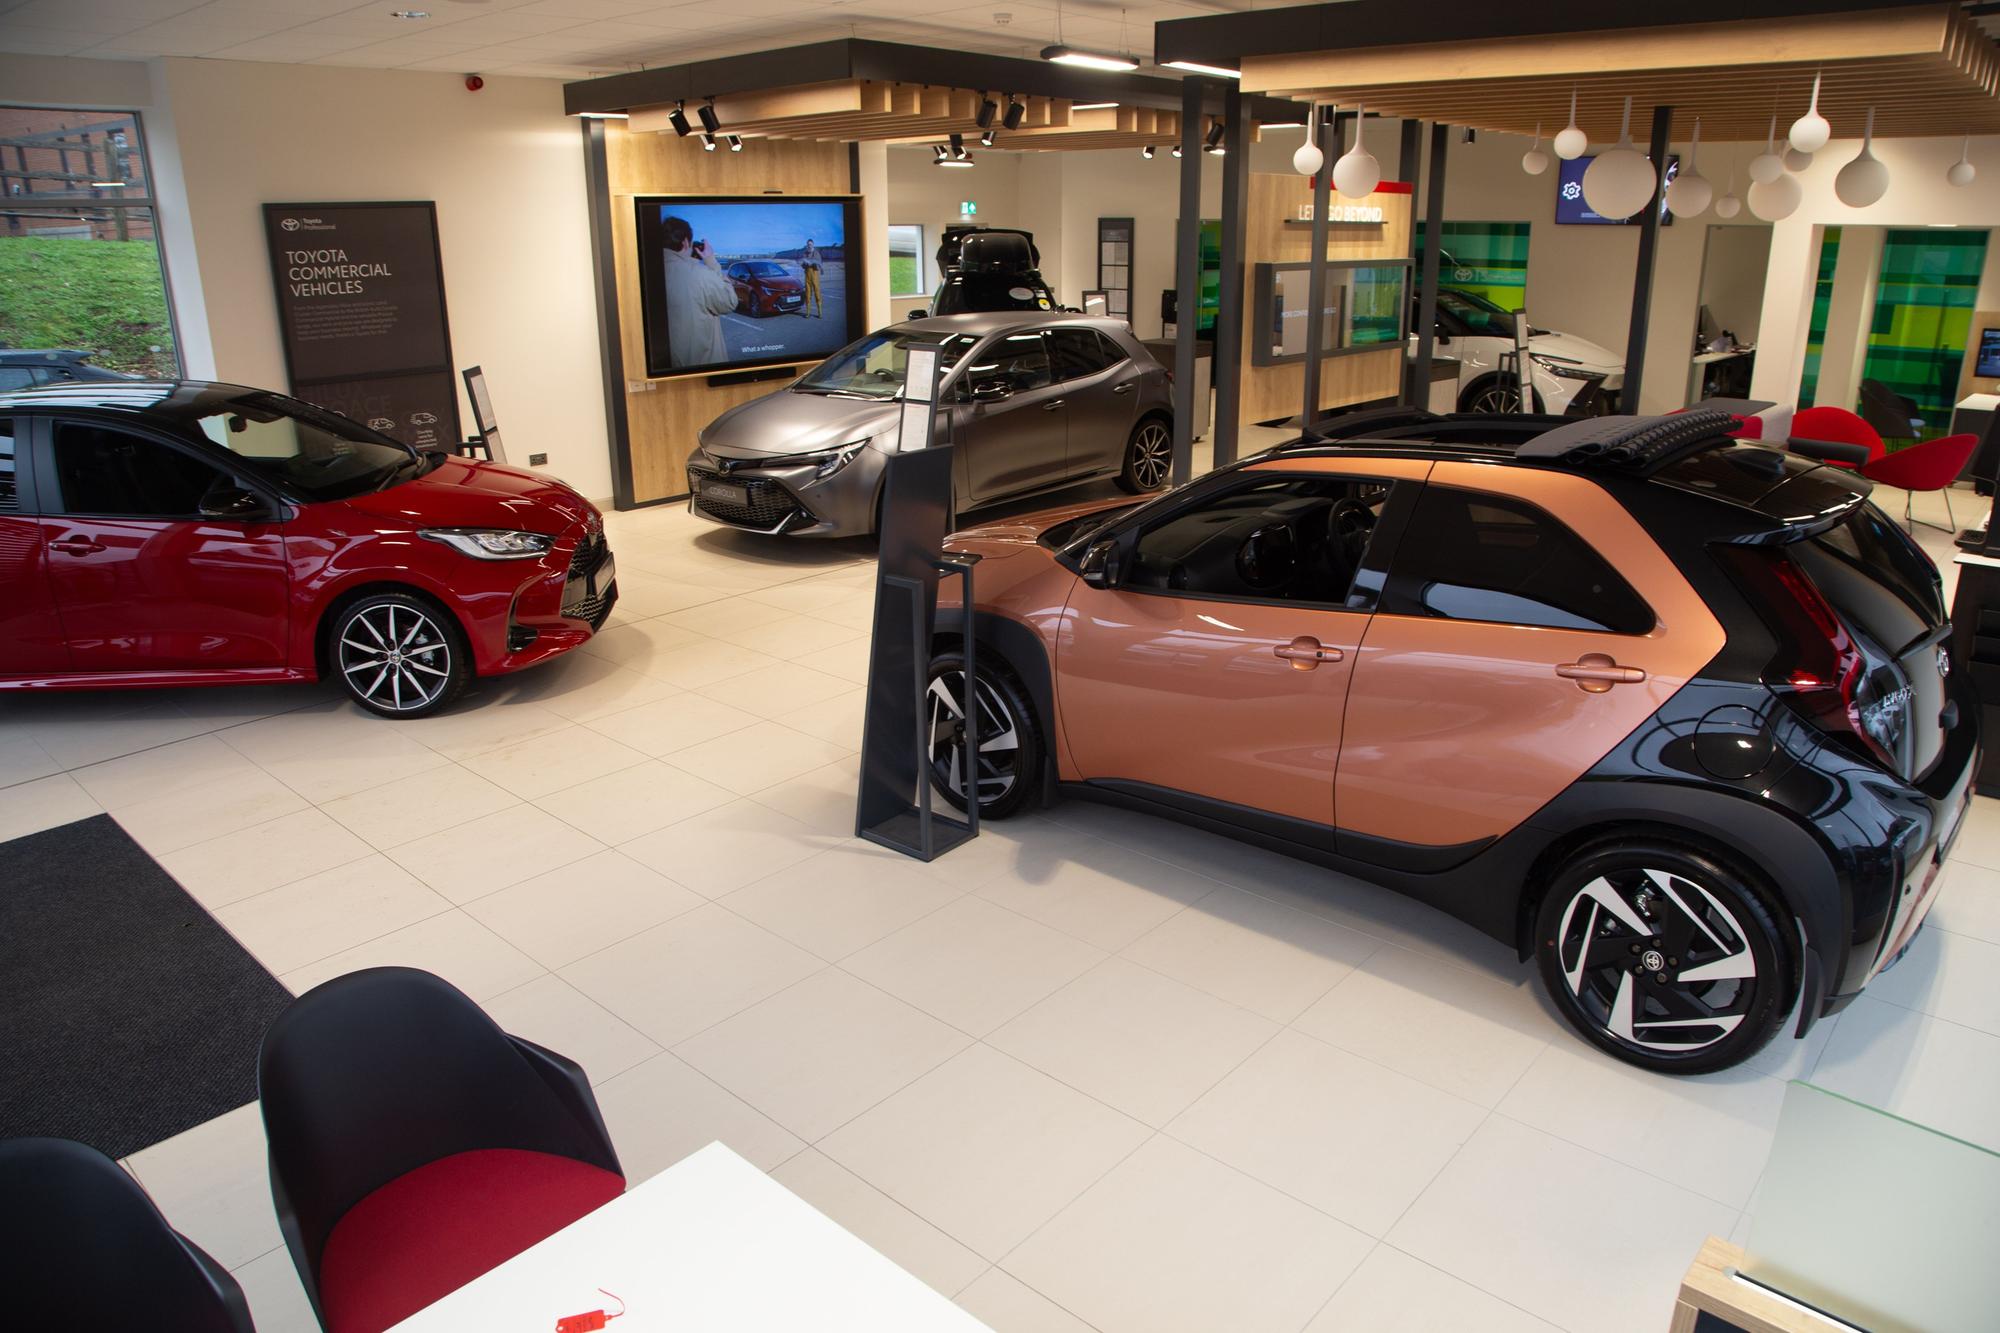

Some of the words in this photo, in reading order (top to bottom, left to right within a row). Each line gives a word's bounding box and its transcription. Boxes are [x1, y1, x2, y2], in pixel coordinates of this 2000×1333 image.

[1344, 206, 1382, 221] BEYOND
[286, 250, 348, 264] TOYOTA
[289, 264, 392, 281] COMMERCIAL
[290, 280, 363, 297] VEHICLES
[710, 486, 737, 498] COROLLA
